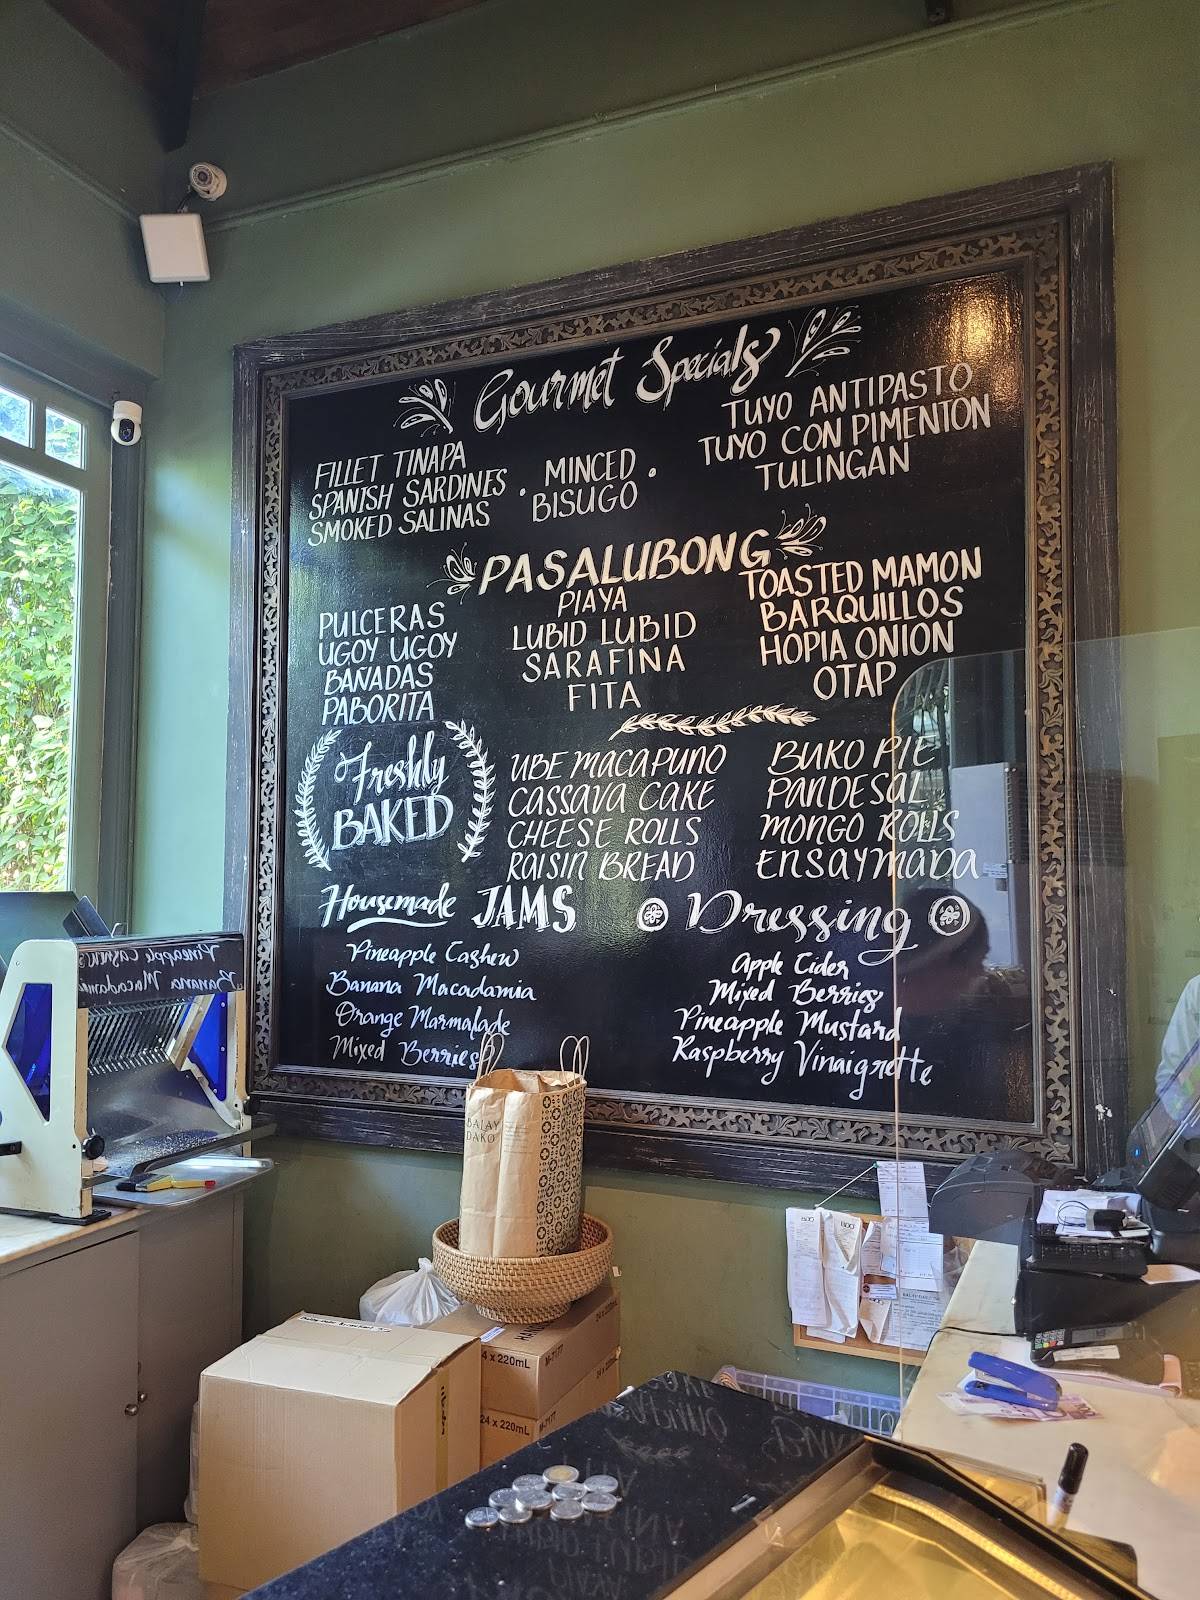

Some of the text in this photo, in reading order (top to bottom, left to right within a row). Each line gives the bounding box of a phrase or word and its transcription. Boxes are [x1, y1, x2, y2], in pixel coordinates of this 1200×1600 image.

[473, 324, 781, 435] Gourmet Specials
[721, 361, 973, 430] TUYO ANTIPASTO
[697, 393, 992, 466] TUYO CON PIMENTON
[314, 440, 467, 490] FILLET TINAPA
[545, 447, 637, 488] MINCED
[755, 442, 910, 491] TULINGAN
[308, 468, 508, 522] SPANISH SARDINES
[532, 480, 639, 523] BISUGO
[307, 500, 491, 547] SMOKED SALINAS
[477, 528, 771, 596] PASALUBONG
[738, 546, 983, 601] TOASTED MAMON
[318, 601, 446, 640] PULCERAS
[556, 585, 628, 618] PIAYA
[759, 585, 965, 633] BARQUILLOS
[318, 631, 458, 667] UGOY UGOY
[512, 610, 698, 652] LUBID LUBID
[759, 620, 955, 667] HOPIA ONION
[323, 661, 434, 696] BAÑADAS
[521, 643, 686, 684] SARAFINA
[813, 661, 897, 701] OTAP
[320, 690, 435, 726] PABORITA
[568, 681, 642, 712] FITA
[333, 730, 450, 805] Freshly
[510, 752, 570, 784] UBE
[768, 734, 938, 776] BUKO PIE
[638, 778, 717, 815] CAKE
[331, 794, 454, 852] BAKED
[506, 815, 702, 850] CHEESE ROLLS
[877, 808, 960, 843] ROLLS
[598, 849, 697, 882] BREAD
[319, 883, 576, 932] Housemade JAMS
[685, 889, 919, 966] Dressing
[346, 939, 520, 970] Pineapple Cashew
[793, 950, 851, 979] Cider
[326, 970, 536, 1001] Banana Macadamia
[708, 978, 884, 1014] Mixed Berries
[335, 1001, 511, 1040] Orange Marmalade
[674, 1004, 902, 1042] Pineapple Mustard
[329, 1035, 479, 1071] Mixed Berries
[672, 1035, 933, 1101] Raspberry Vinaigrette
[466, 1118, 500, 1133] BALAY
[466, 1131, 495, 1144] DAKO
[497, 1354, 530, 1369] 220mL
[500, 1419, 530, 1436] 220mL
